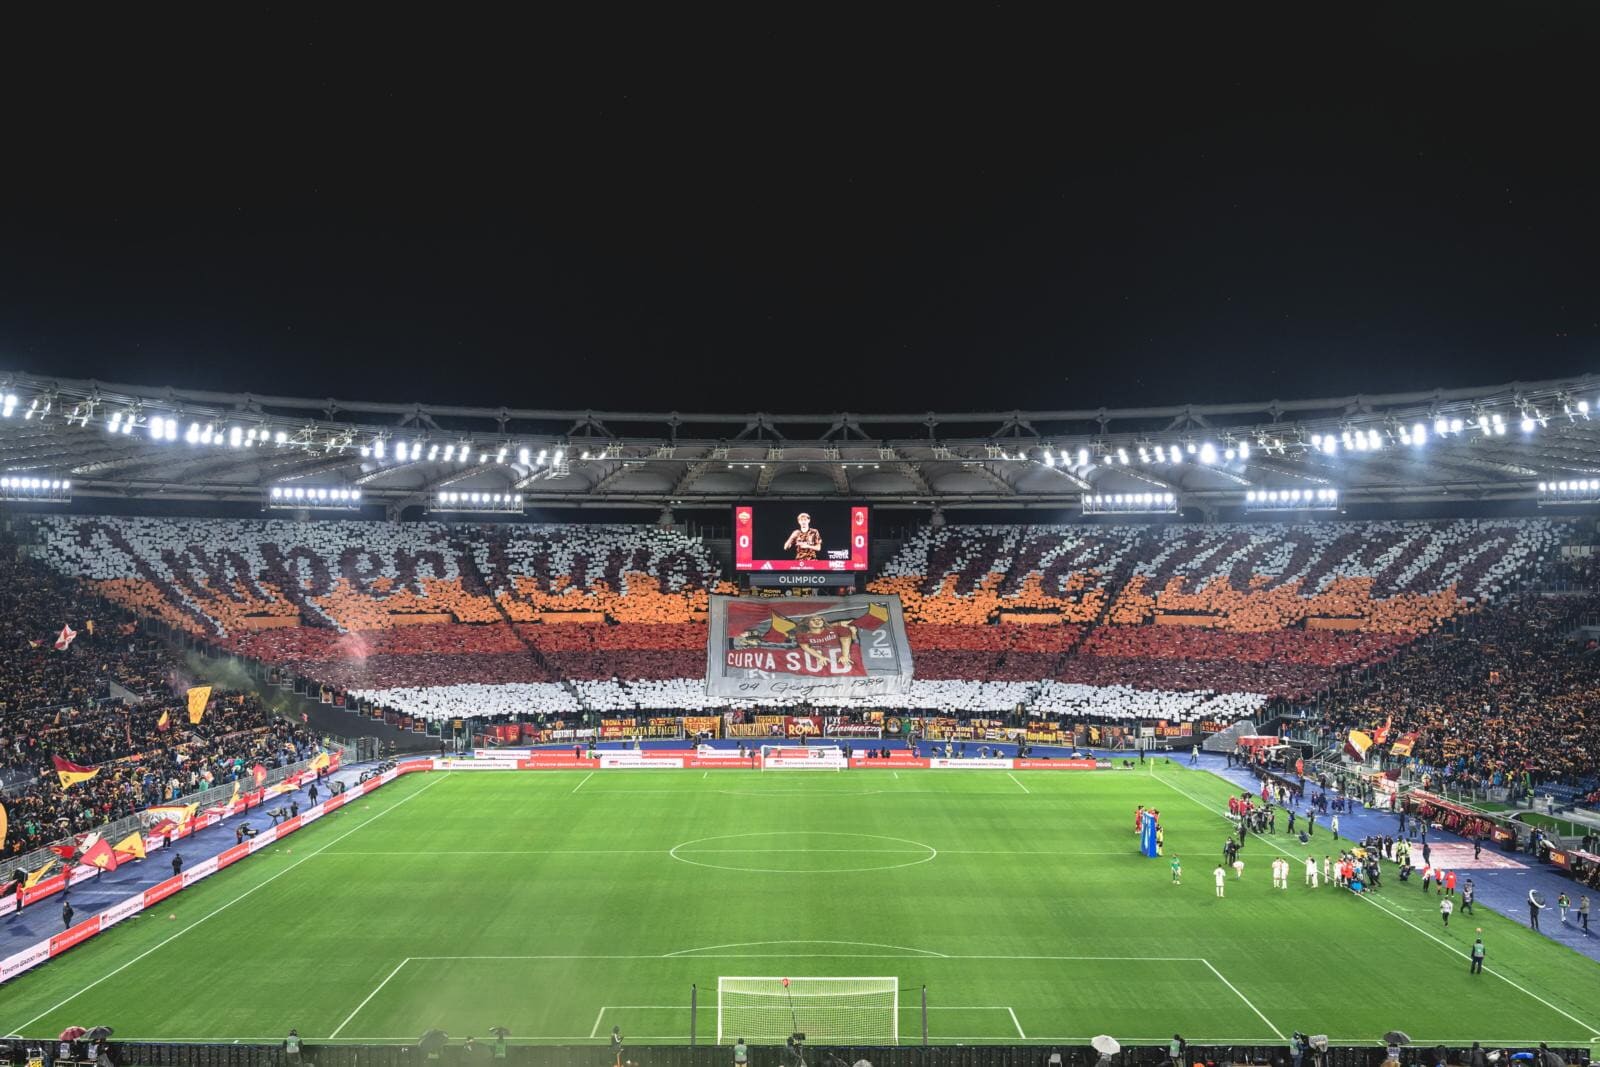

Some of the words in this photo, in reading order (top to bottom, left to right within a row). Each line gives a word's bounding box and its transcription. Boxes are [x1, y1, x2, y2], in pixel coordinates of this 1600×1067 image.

[739, 535, 750, 548] 0
[855, 535, 865, 548] 0
[779, 576, 826, 584] OLIMPICO
[872, 629, 890, 648] 2
[727, 653, 776, 670] CURVA
[785, 648, 853, 675] SUD
[739, 682, 760, 691] 04
[851, 678, 884, 688] 1989
[788, 724, 821, 735] ROMA
